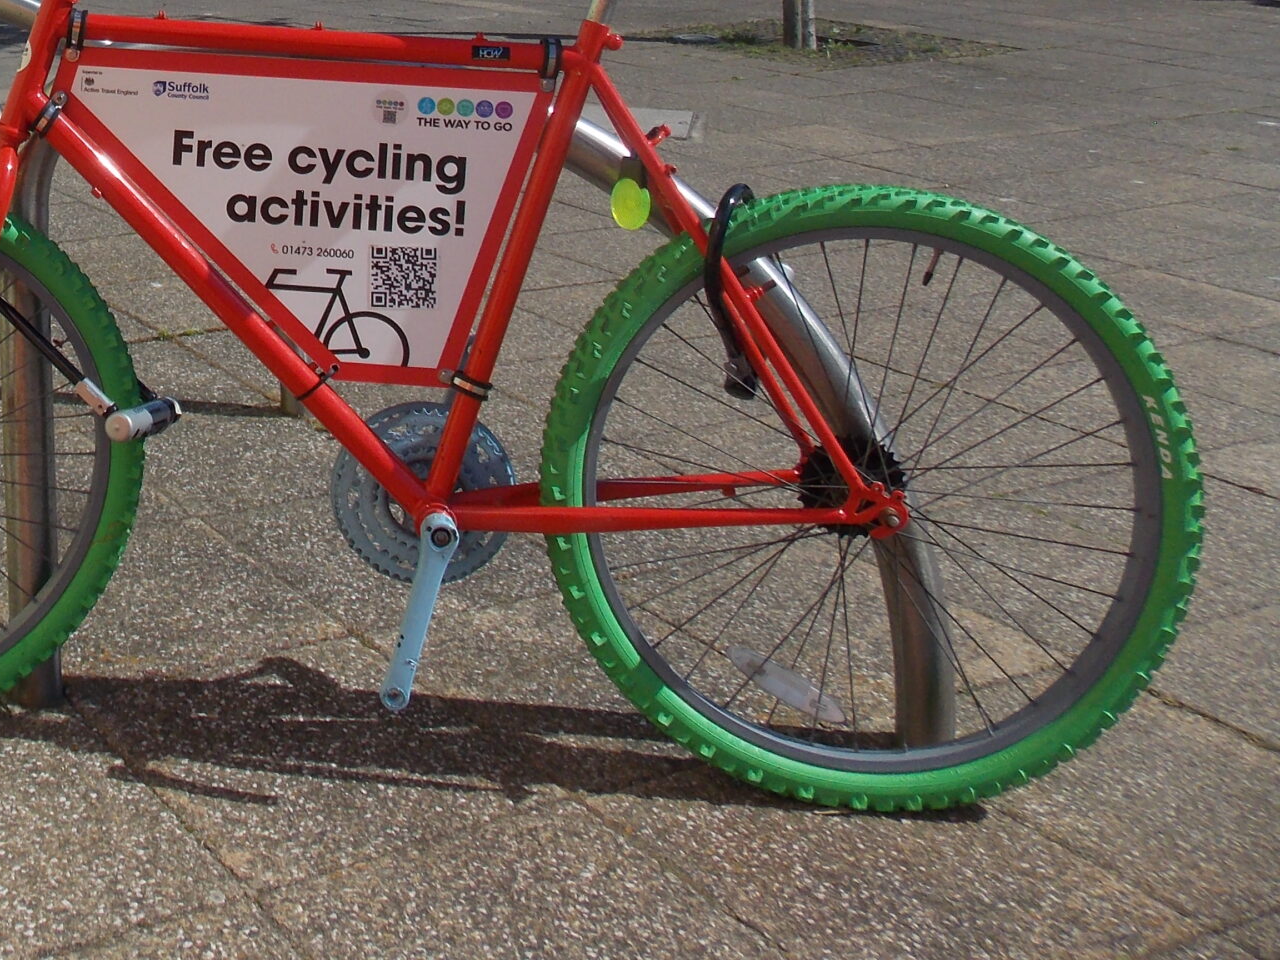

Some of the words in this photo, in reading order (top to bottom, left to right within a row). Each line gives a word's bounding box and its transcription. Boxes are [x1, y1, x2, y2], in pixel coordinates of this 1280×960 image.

[167, 81, 209, 94] Suffolk
[167, 92, 187, 100] County
[416, 117, 440, 128] THE
[443, 119, 471, 129] WAY
[474, 120, 491, 131] TO
[493, 122, 513, 132] GO
[172, 129, 273, 172] Free
[287, 142, 468, 195] cycling
[226, 189, 466, 237] activities!
[281, 244, 314, 257] 01473
[316, 247, 355, 260] 260060
[1141, 394, 1173, 480] KENDA
